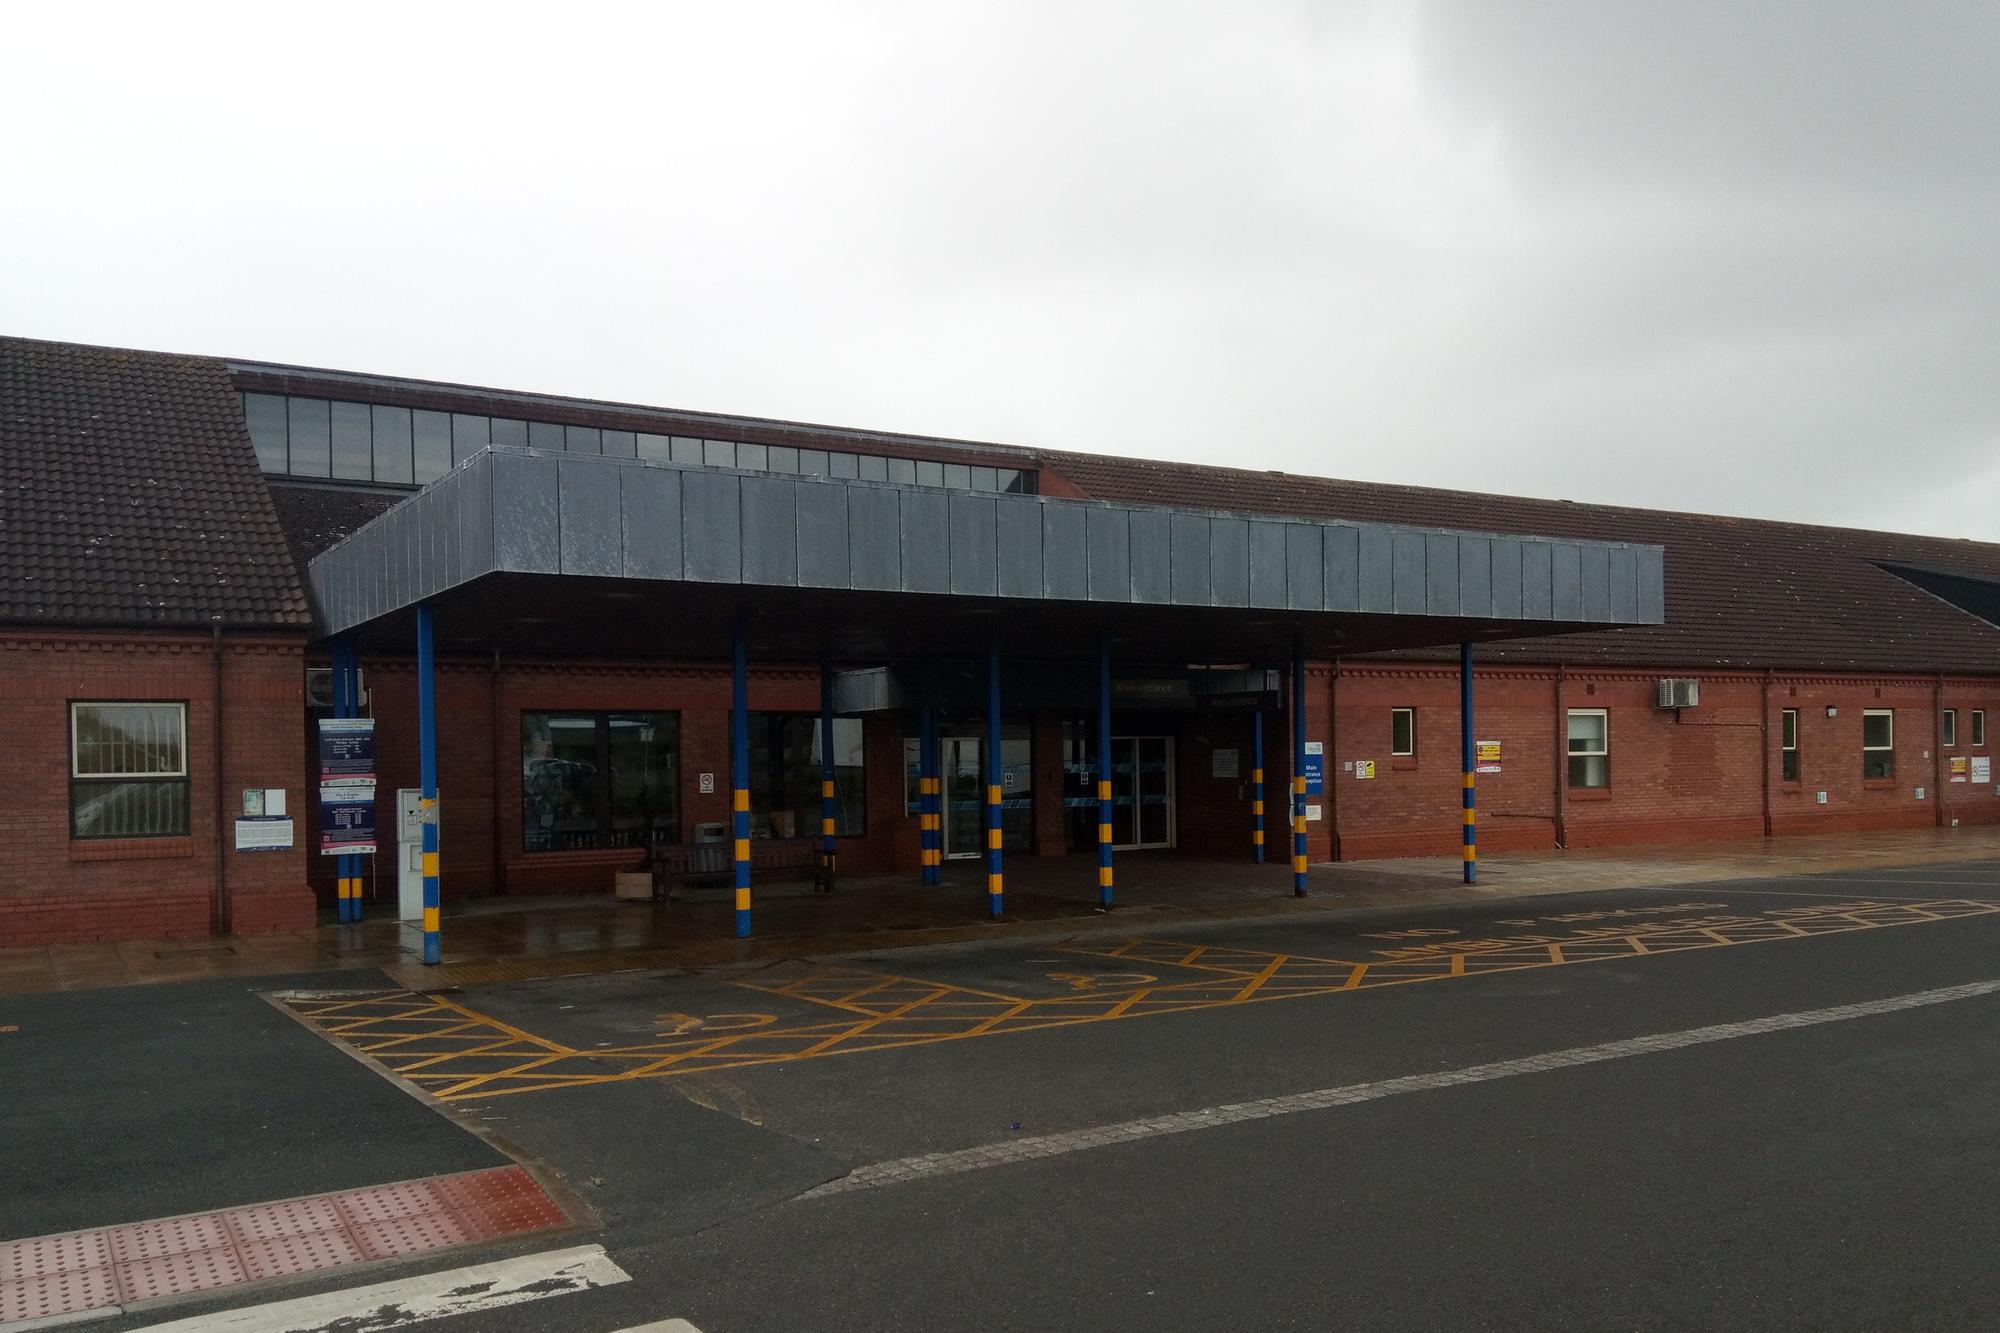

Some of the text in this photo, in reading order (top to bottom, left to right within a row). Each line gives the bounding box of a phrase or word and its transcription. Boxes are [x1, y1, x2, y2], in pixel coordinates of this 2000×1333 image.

[1358, 902, 1729, 940] NO PARKING
[1368, 900, 1896, 958] AMBULANCES ONLY
